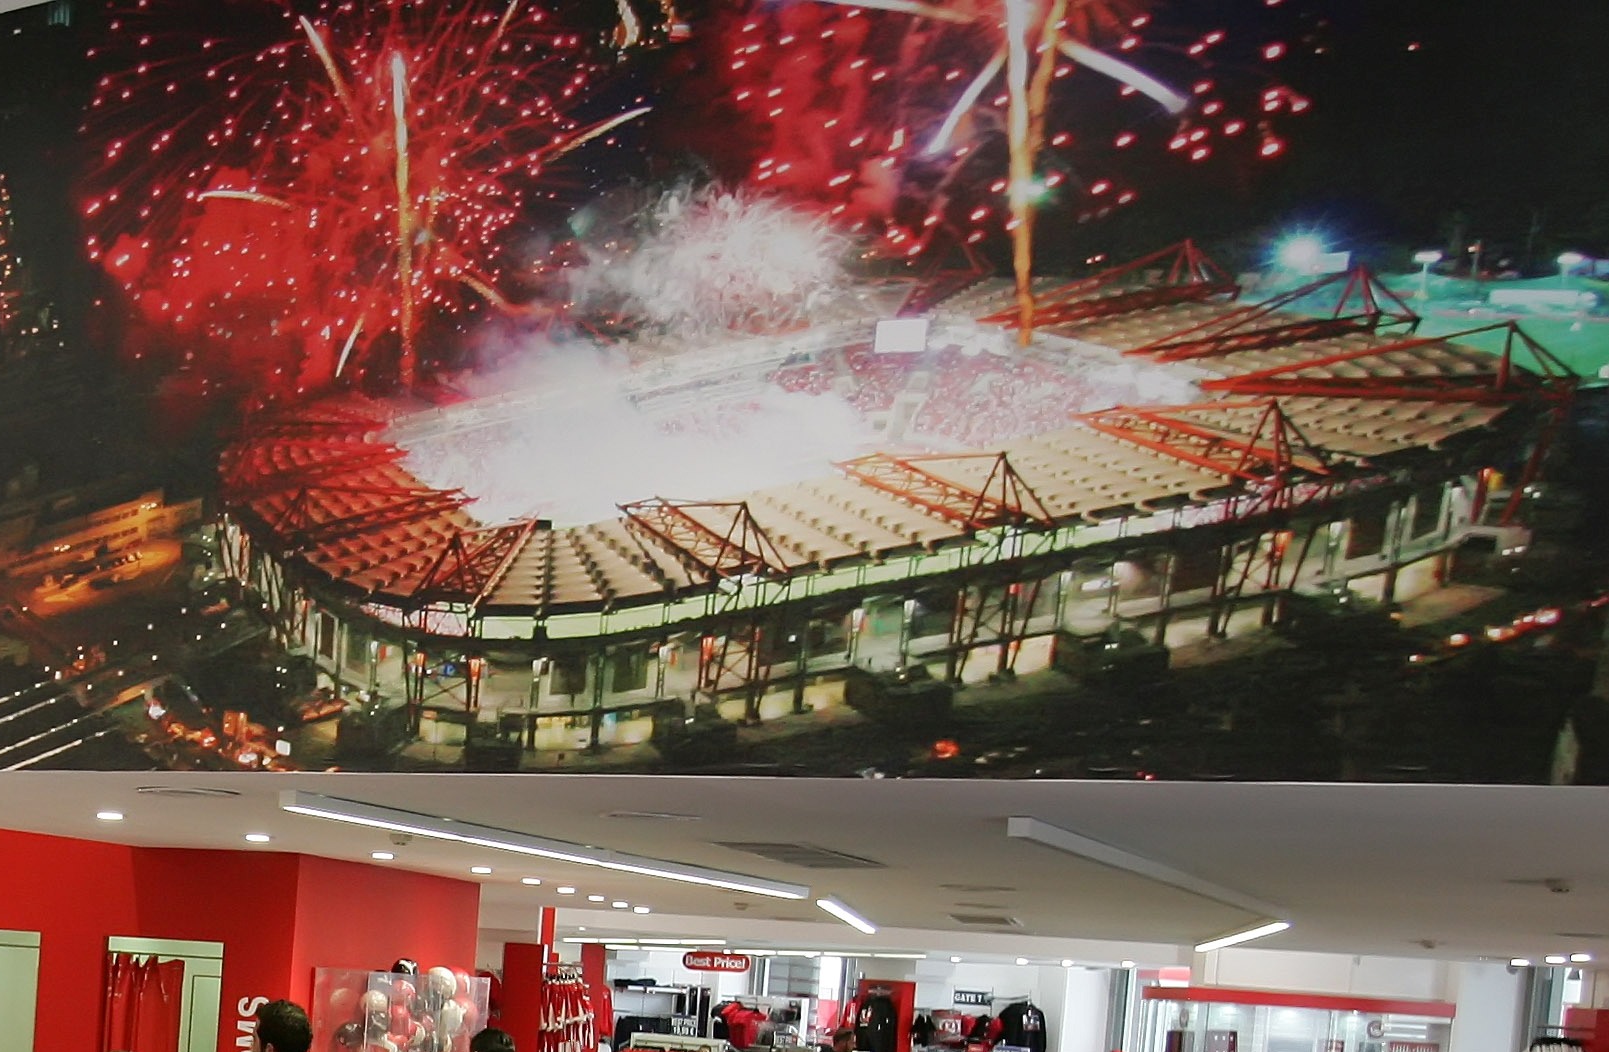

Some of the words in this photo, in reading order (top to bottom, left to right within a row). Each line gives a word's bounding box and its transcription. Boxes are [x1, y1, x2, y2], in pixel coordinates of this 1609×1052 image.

[685, 955, 711, 967] Best
[714, 956, 746, 969] Price!
[955, 993, 977, 1002] GATE
